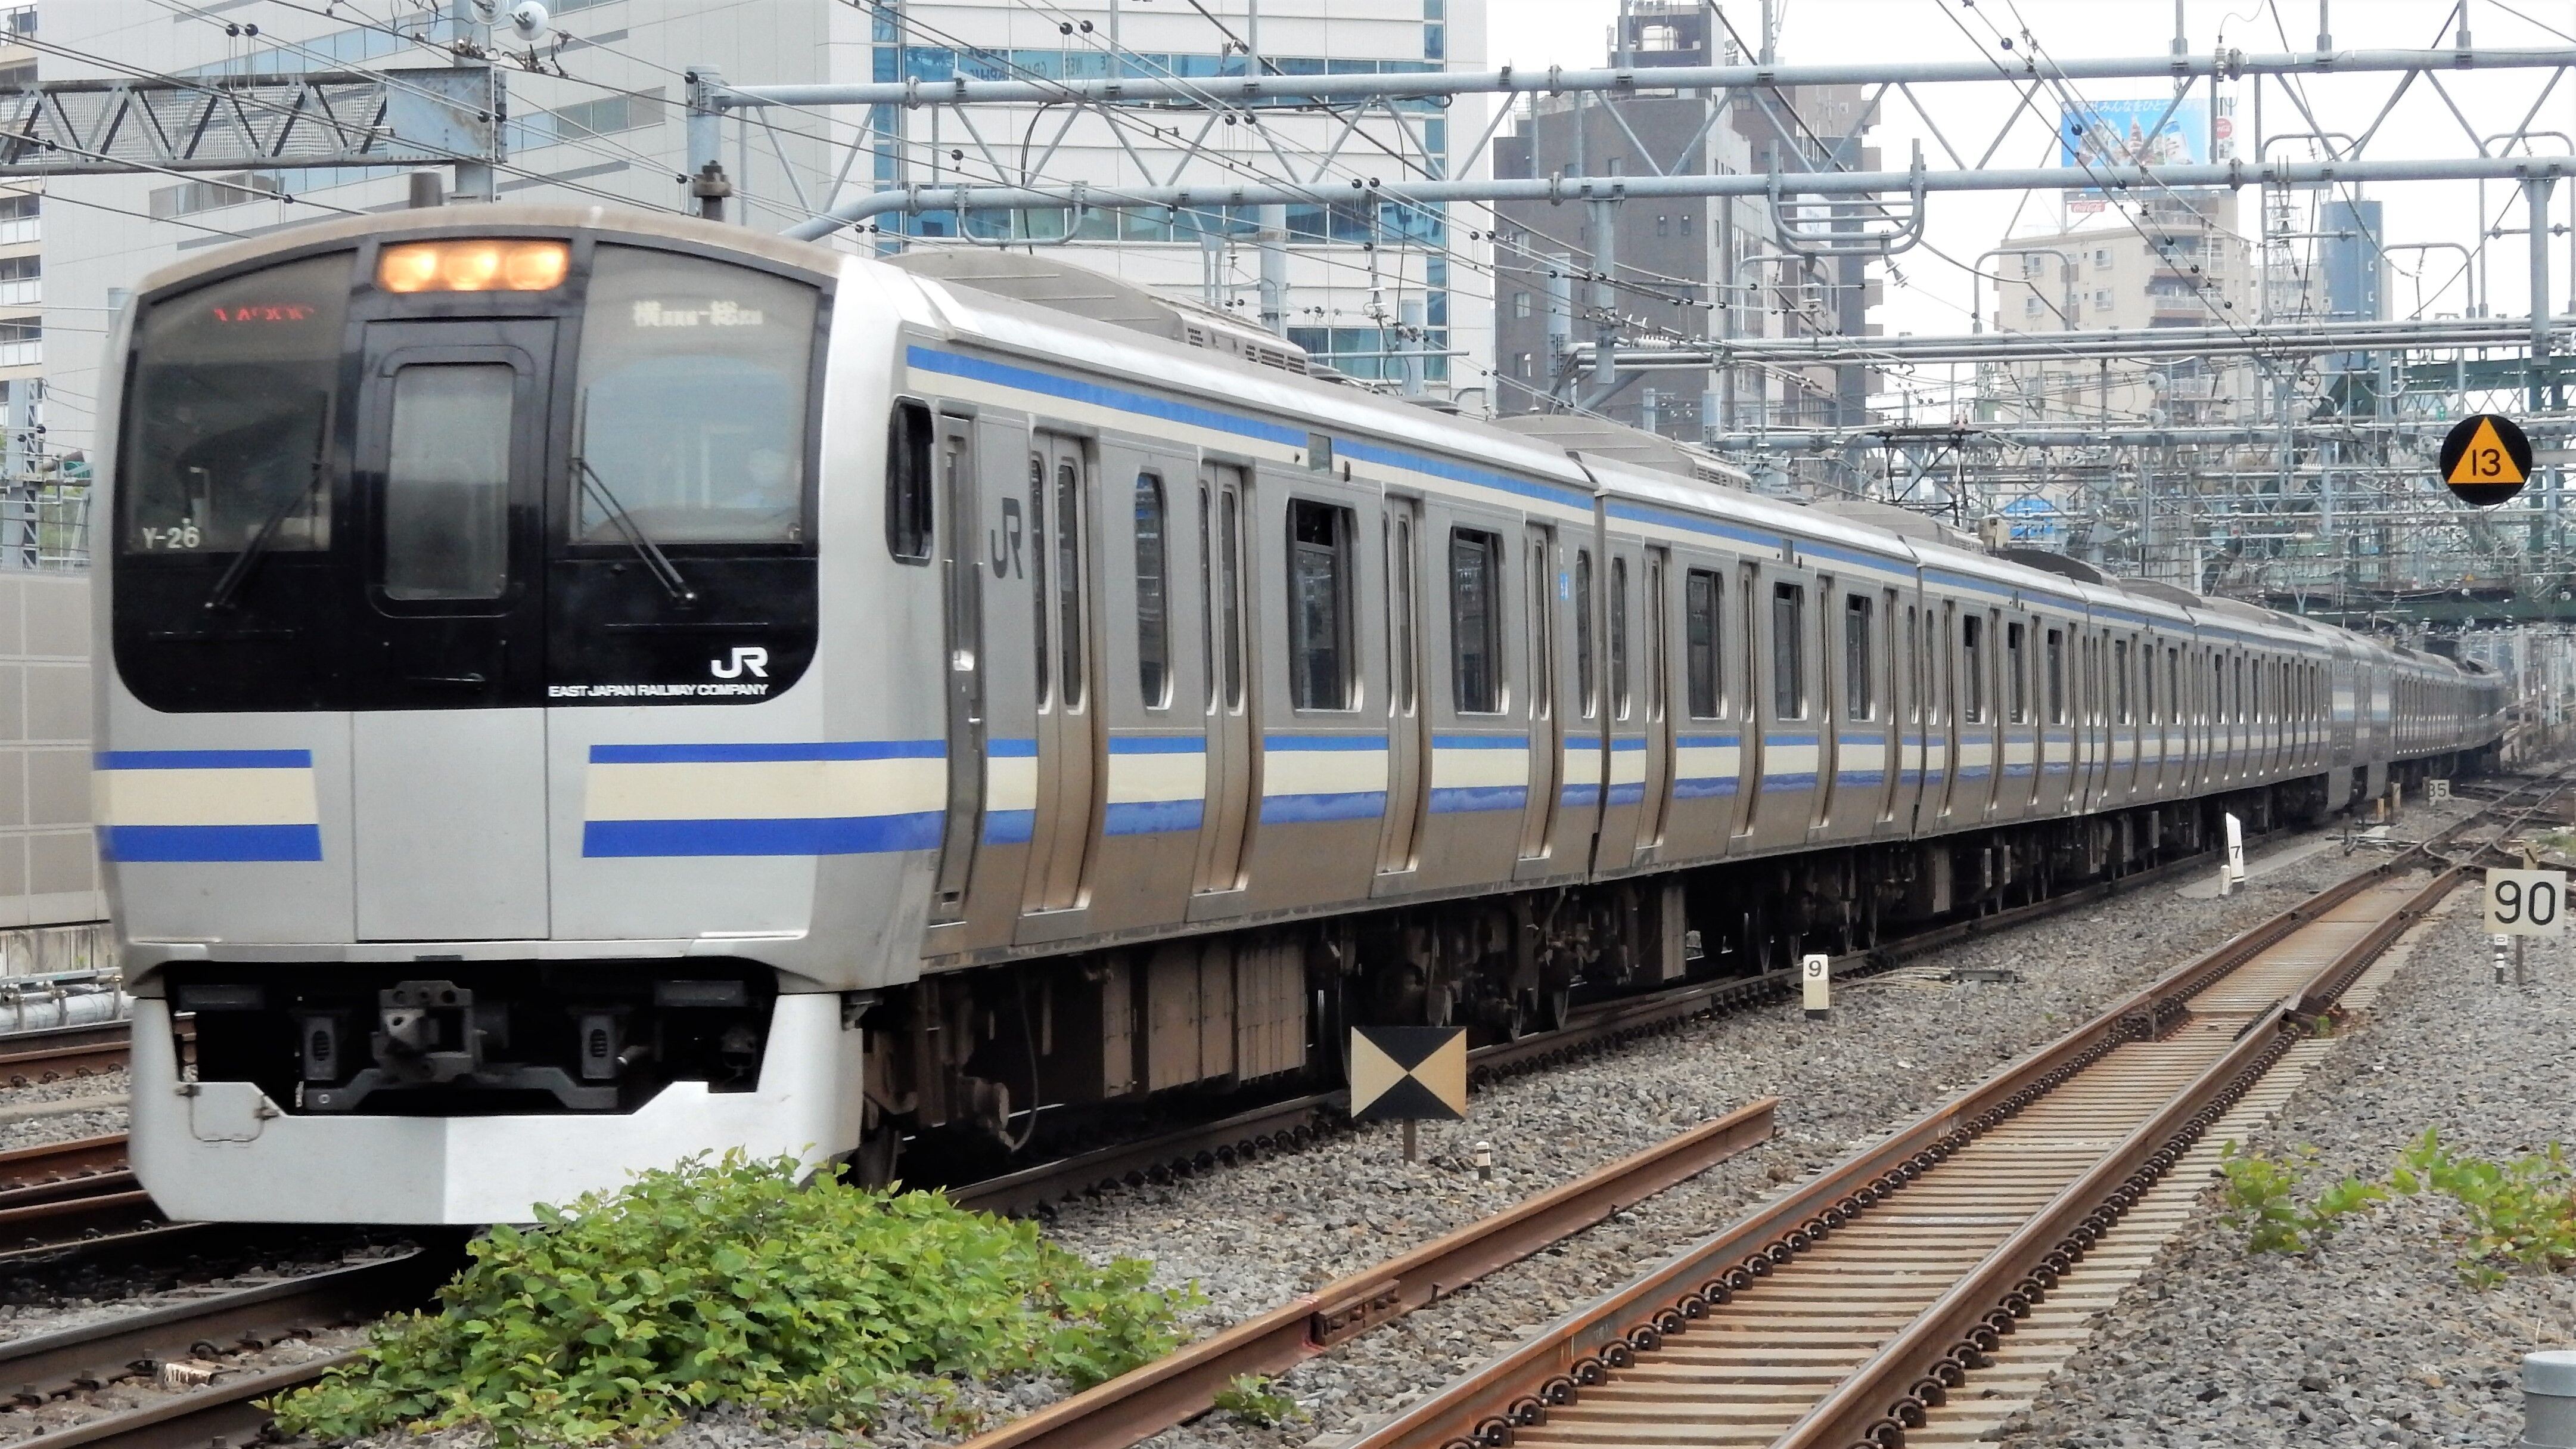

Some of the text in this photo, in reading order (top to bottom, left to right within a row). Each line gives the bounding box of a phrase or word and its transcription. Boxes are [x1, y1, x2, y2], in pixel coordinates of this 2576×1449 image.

[2472, 449, 2501, 477] 13
[142, 526, 200, 548] Y-26
[991, 497, 1023, 579] JR
[710, 646, 769, 679] JR
[548, 684, 769, 697] EAST JAPAN RAILWAY COMPANY
[2230, 845, 2241, 859] 7
[2495, 880, 2556, 925] 90
[1809, 960, 1822, 977] 9
